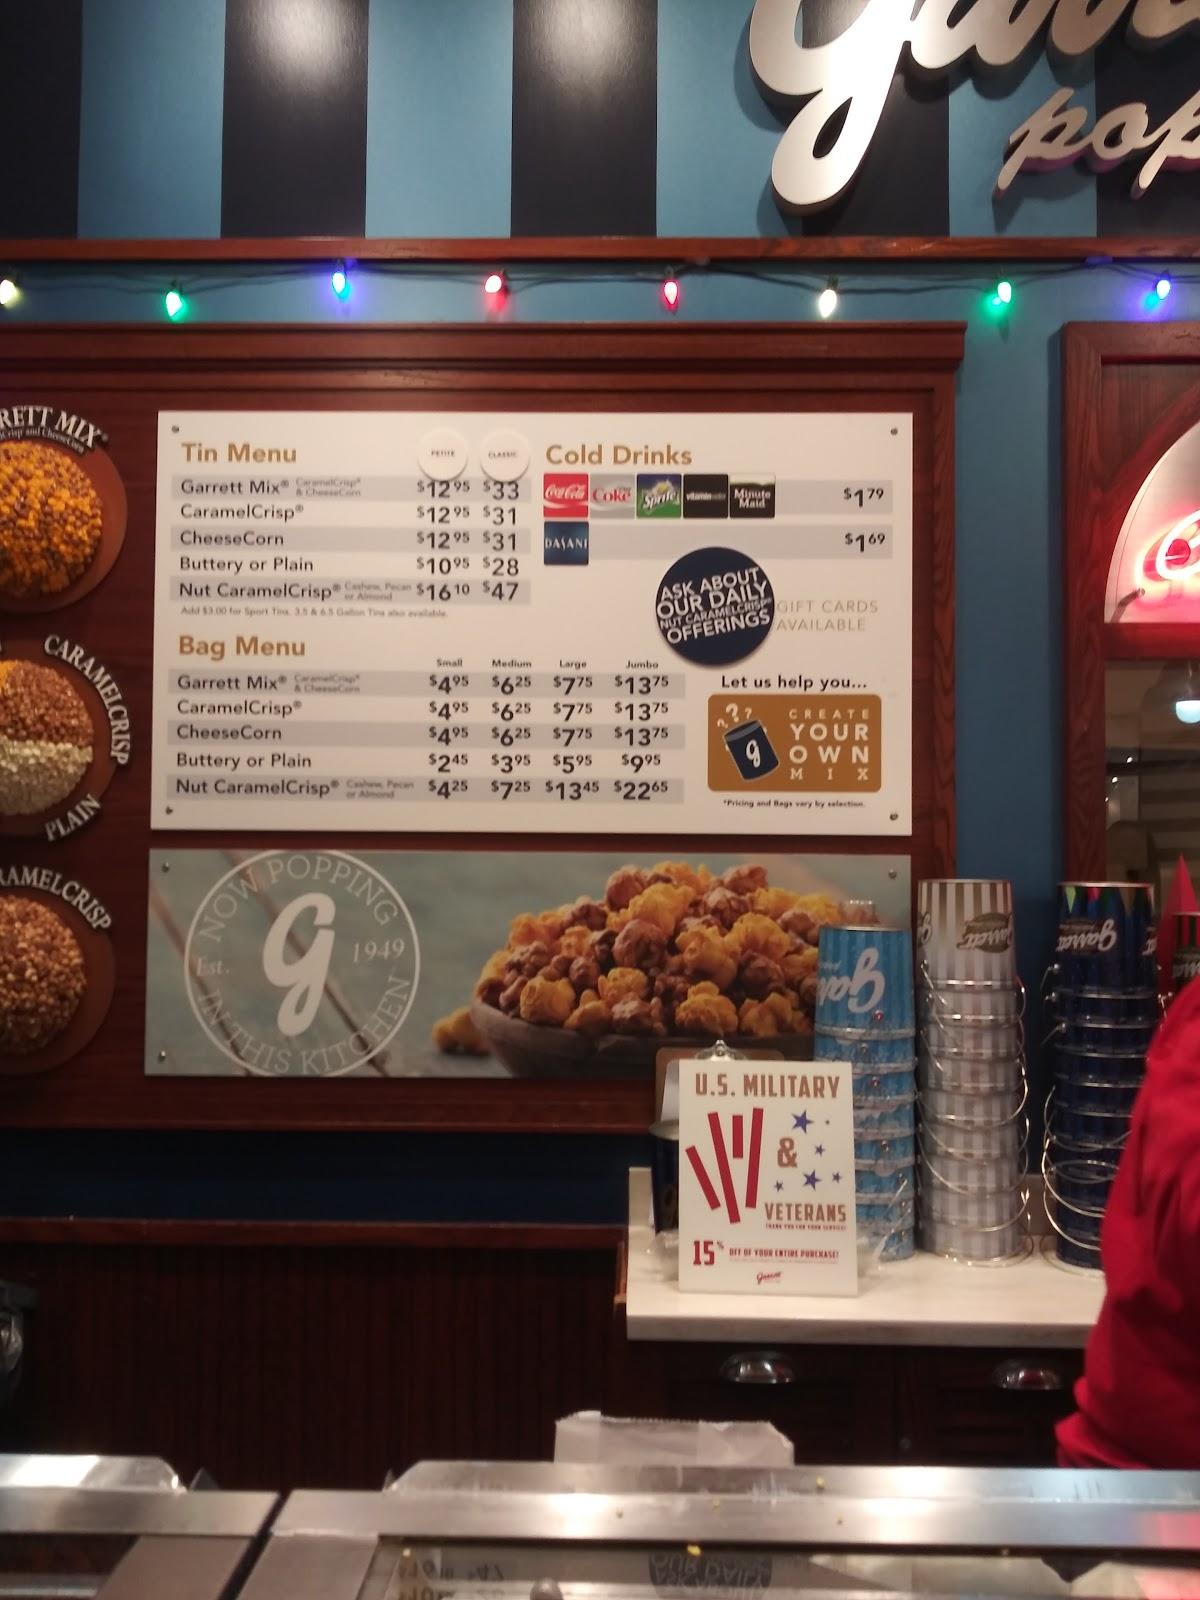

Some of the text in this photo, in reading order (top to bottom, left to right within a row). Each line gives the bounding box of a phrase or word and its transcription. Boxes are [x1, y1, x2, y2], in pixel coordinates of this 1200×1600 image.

[181, 442, 297, 463] Tin Menu
[488, 451, 518, 459] CLASSIC
[546, 444, 693, 466] Cold Drinks
[180, 479, 243, 496] Garrett
[483, 480, 520, 501] $33
[592, 486, 631, 503] Coke
[734, 488, 771, 500] Minute
[643, 489, 680, 510] Sprite
[739, 498, 767, 509] Maid
[482, 506, 518, 525] $31
[180, 530, 285, 547] CheeseCorn
[482, 532, 518, 551] $31
[544, 537, 588, 551] DASANI
[180, 556, 243, 575] Buttery
[248, 560, 266, 572] or
[273, 556, 314, 571] Plain
[482, 557, 520, 576] $28
[179, 583, 211, 598] Nut
[481, 582, 519, 601] $47
[384, 583, 413, 593] Pecan
[661, 566, 759, 602] ASK ABOUT
[344, 592, 393, 602] or Almond
[656, 580, 767, 620] OUR DAILY
[181, 607, 200, 616] Add
[202, 607, 227, 617] $3.00
[229, 607, 241, 616] for
[244, 607, 270, 619] Sport
[310, 607, 318, 617] &
[336, 607, 366, 618] Gallon
[387, 608, 406, 618] also
[776, 600, 878, 614] GIFT CARDS
[660, 616, 682, 630] NUT
[666, 608, 771, 644] OFFERINGS
[776, 618, 866, 632] AVAILABLE
[178, 636, 306, 661] Bag Menu
[436, 658, 463, 668] Small
[491, 659, 532, 669] Medium
[558, 660, 588, 671] Large
[625, 660, 660, 669] Jumbo
[177, 675, 242, 690] Garrett
[721, 675, 748, 690] Let
[753, 678, 772, 690] us
[777, 675, 815, 692] help
[44, 634, 131, 765] CARAMELCRISP
[789, 708, 870, 720] CREATE
[176, 724, 282, 741] CheeseCorn
[790, 723, 869, 742] YOUR
[176, 752, 242, 771] Buttery
[246, 757, 265, 768] or
[271, 752, 312, 768] Plain
[788, 746, 869, 764] OWN
[788, 767, 869, 782] MIX
[176, 780, 208, 794] Nut
[386, 780, 415, 790] Pecan
[346, 790, 395, 800] or Almond
[756, 799, 771, 807] and
[773, 799, 793, 809] Bags
[795, 800, 812, 809] vary
[814, 799, 825, 809] by
[44, 793, 101, 842] PLAIN
[199, 854, 398, 943] NOW POPPING
[351, 938, 406, 963] 1949
[196, 956, 231, 977] Est.
[199, 974, 412, 1076] IN THIS KITCHEN
[695, 1073, 840, 1099] U.S. MILITARY
[777, 1137, 798, 1168] &
[764, 1202, 847, 1223] VETERANS
[729, 1248, 741, 1257] OFF
[743, 1248, 752, 1257] OF
[754, 1248, 773, 1258] YOUR
[775, 1249, 799, 1258] ENTIRE
